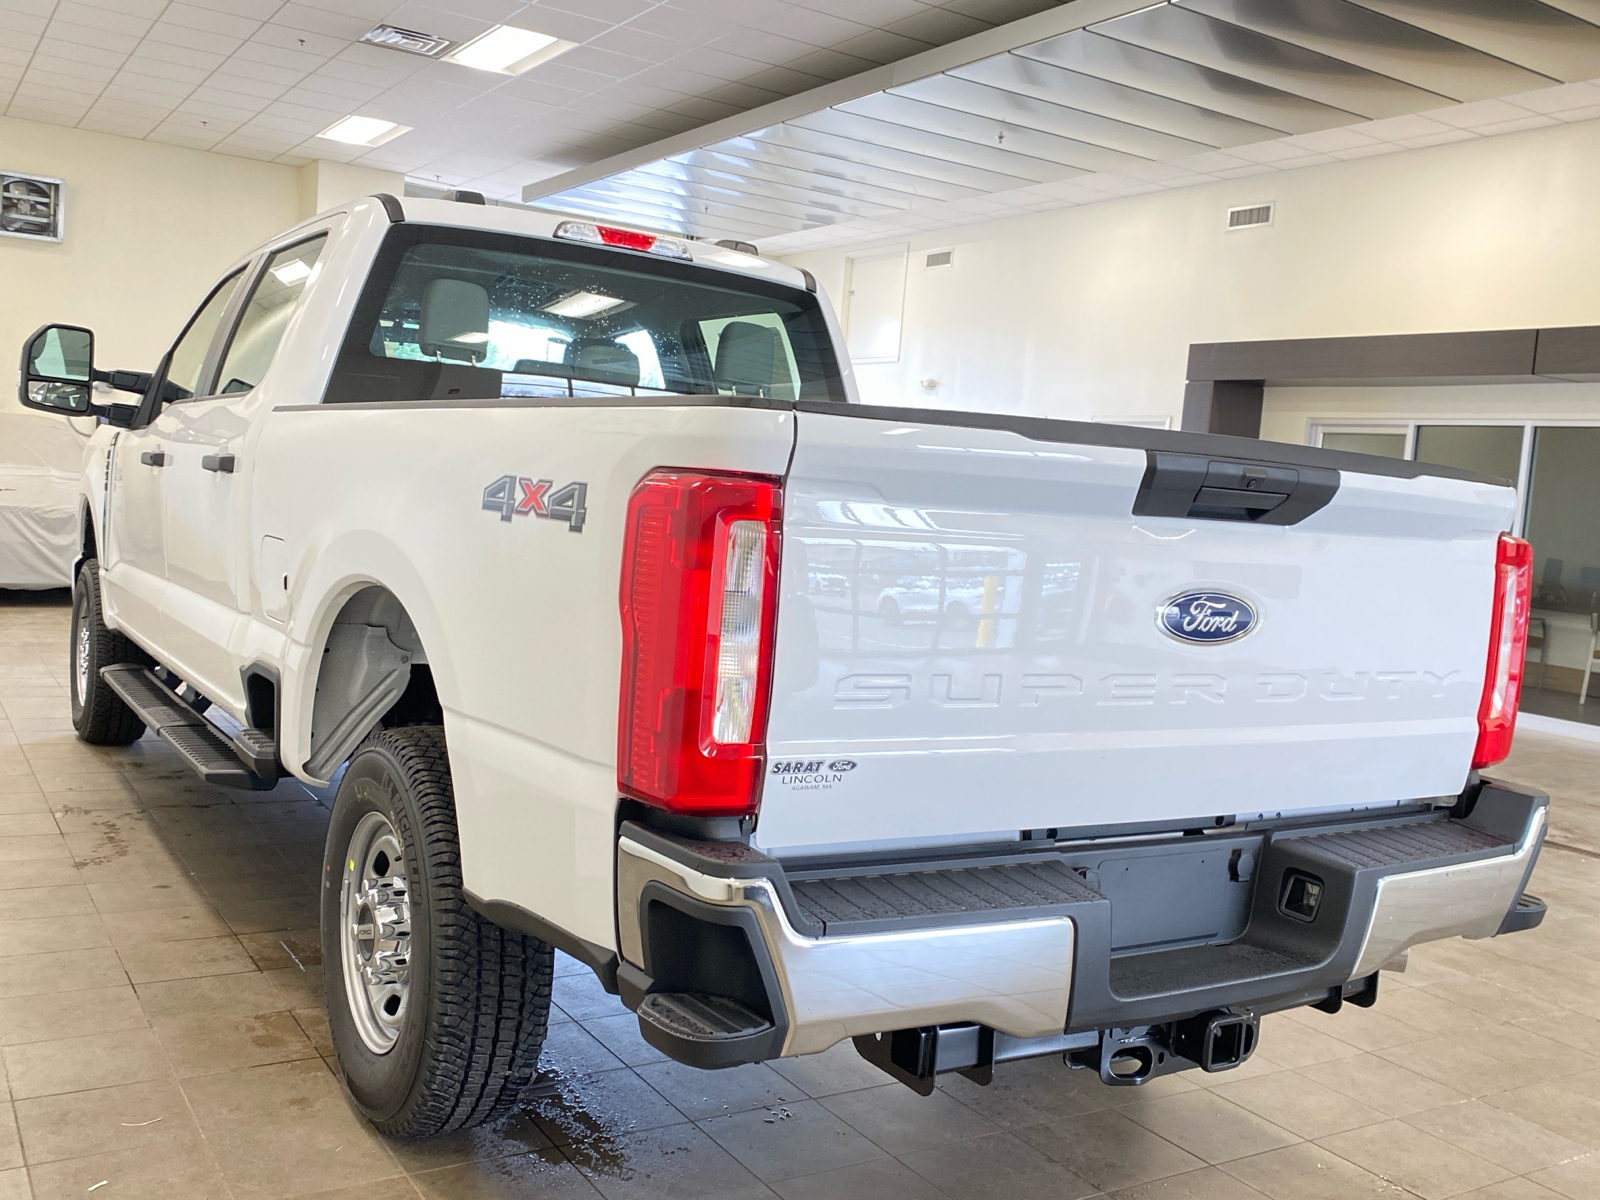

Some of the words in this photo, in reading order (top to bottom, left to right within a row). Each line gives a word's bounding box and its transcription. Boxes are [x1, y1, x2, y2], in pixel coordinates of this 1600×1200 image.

[1183, 595, 1239, 632] Ford
[834, 673, 1227, 709] SUPER
[1254, 670, 1460, 702] DUTY
[771, 761, 825, 774] SARAT
[832, 761, 854, 771] Ford
[781, 774, 843, 785] LINCOLN
[391, 793, 423, 906] MICHELIN
